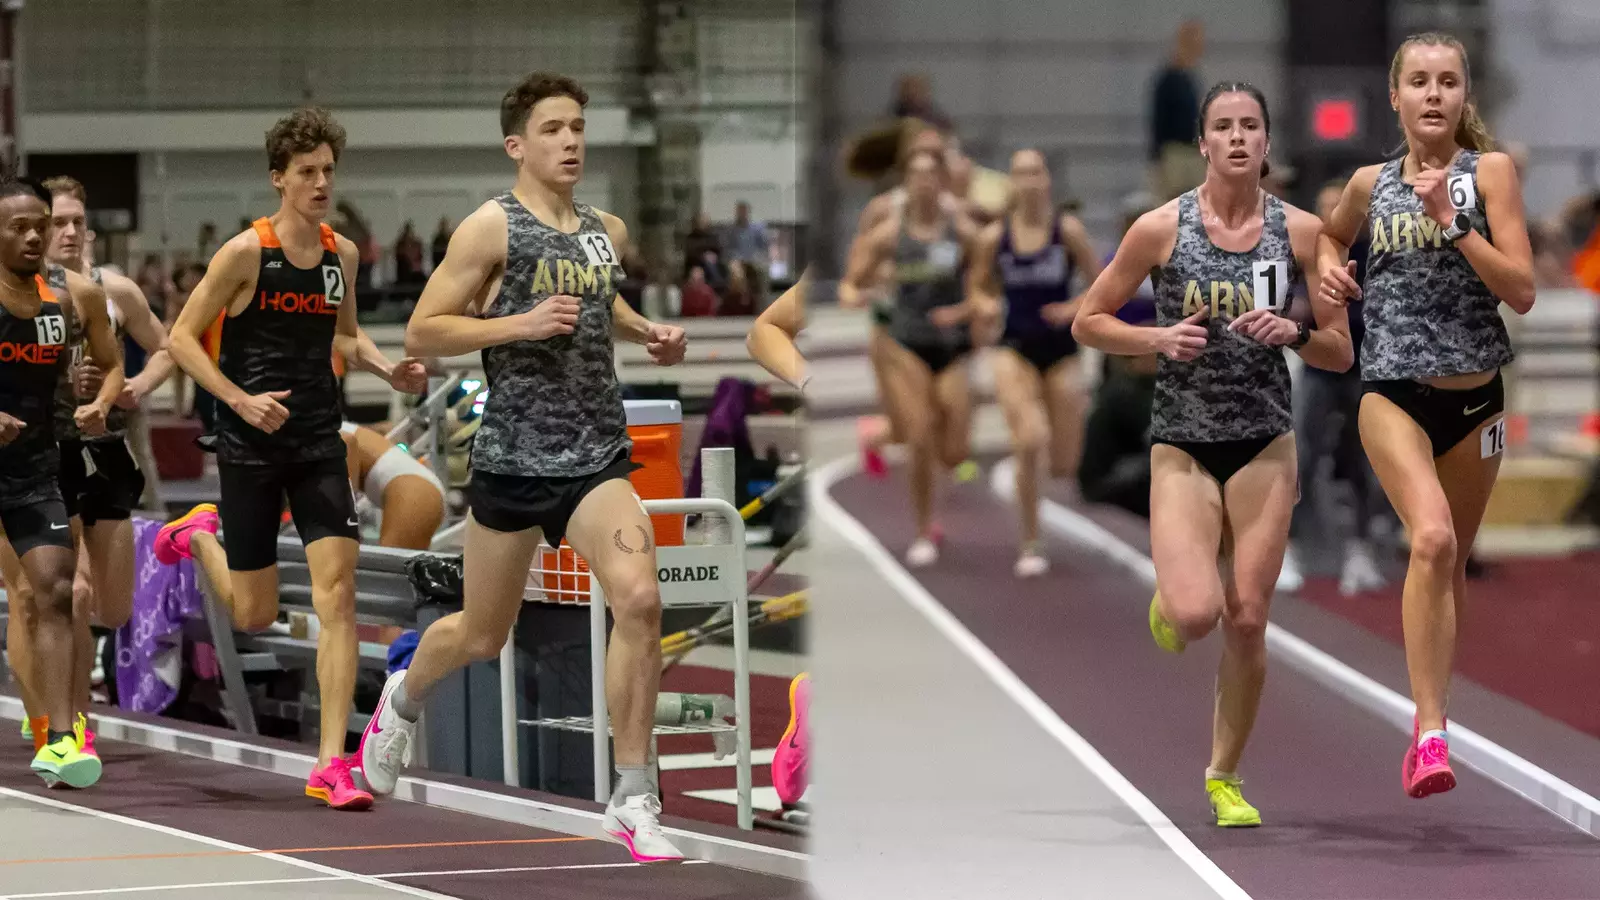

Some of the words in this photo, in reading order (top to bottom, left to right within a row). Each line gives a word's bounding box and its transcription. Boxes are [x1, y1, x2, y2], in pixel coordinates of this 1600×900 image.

[1373, 212, 1458, 255] ARM
[587, 235, 613, 263] 13
[326, 269, 342, 301] 2
[530, 258, 612, 295] ARMY
[1260, 265, 1277, 306] 1
[260, 290, 337, 314] HOKIE
[39, 317, 63, 344] 15
[657, 565, 719, 582] ORADE
